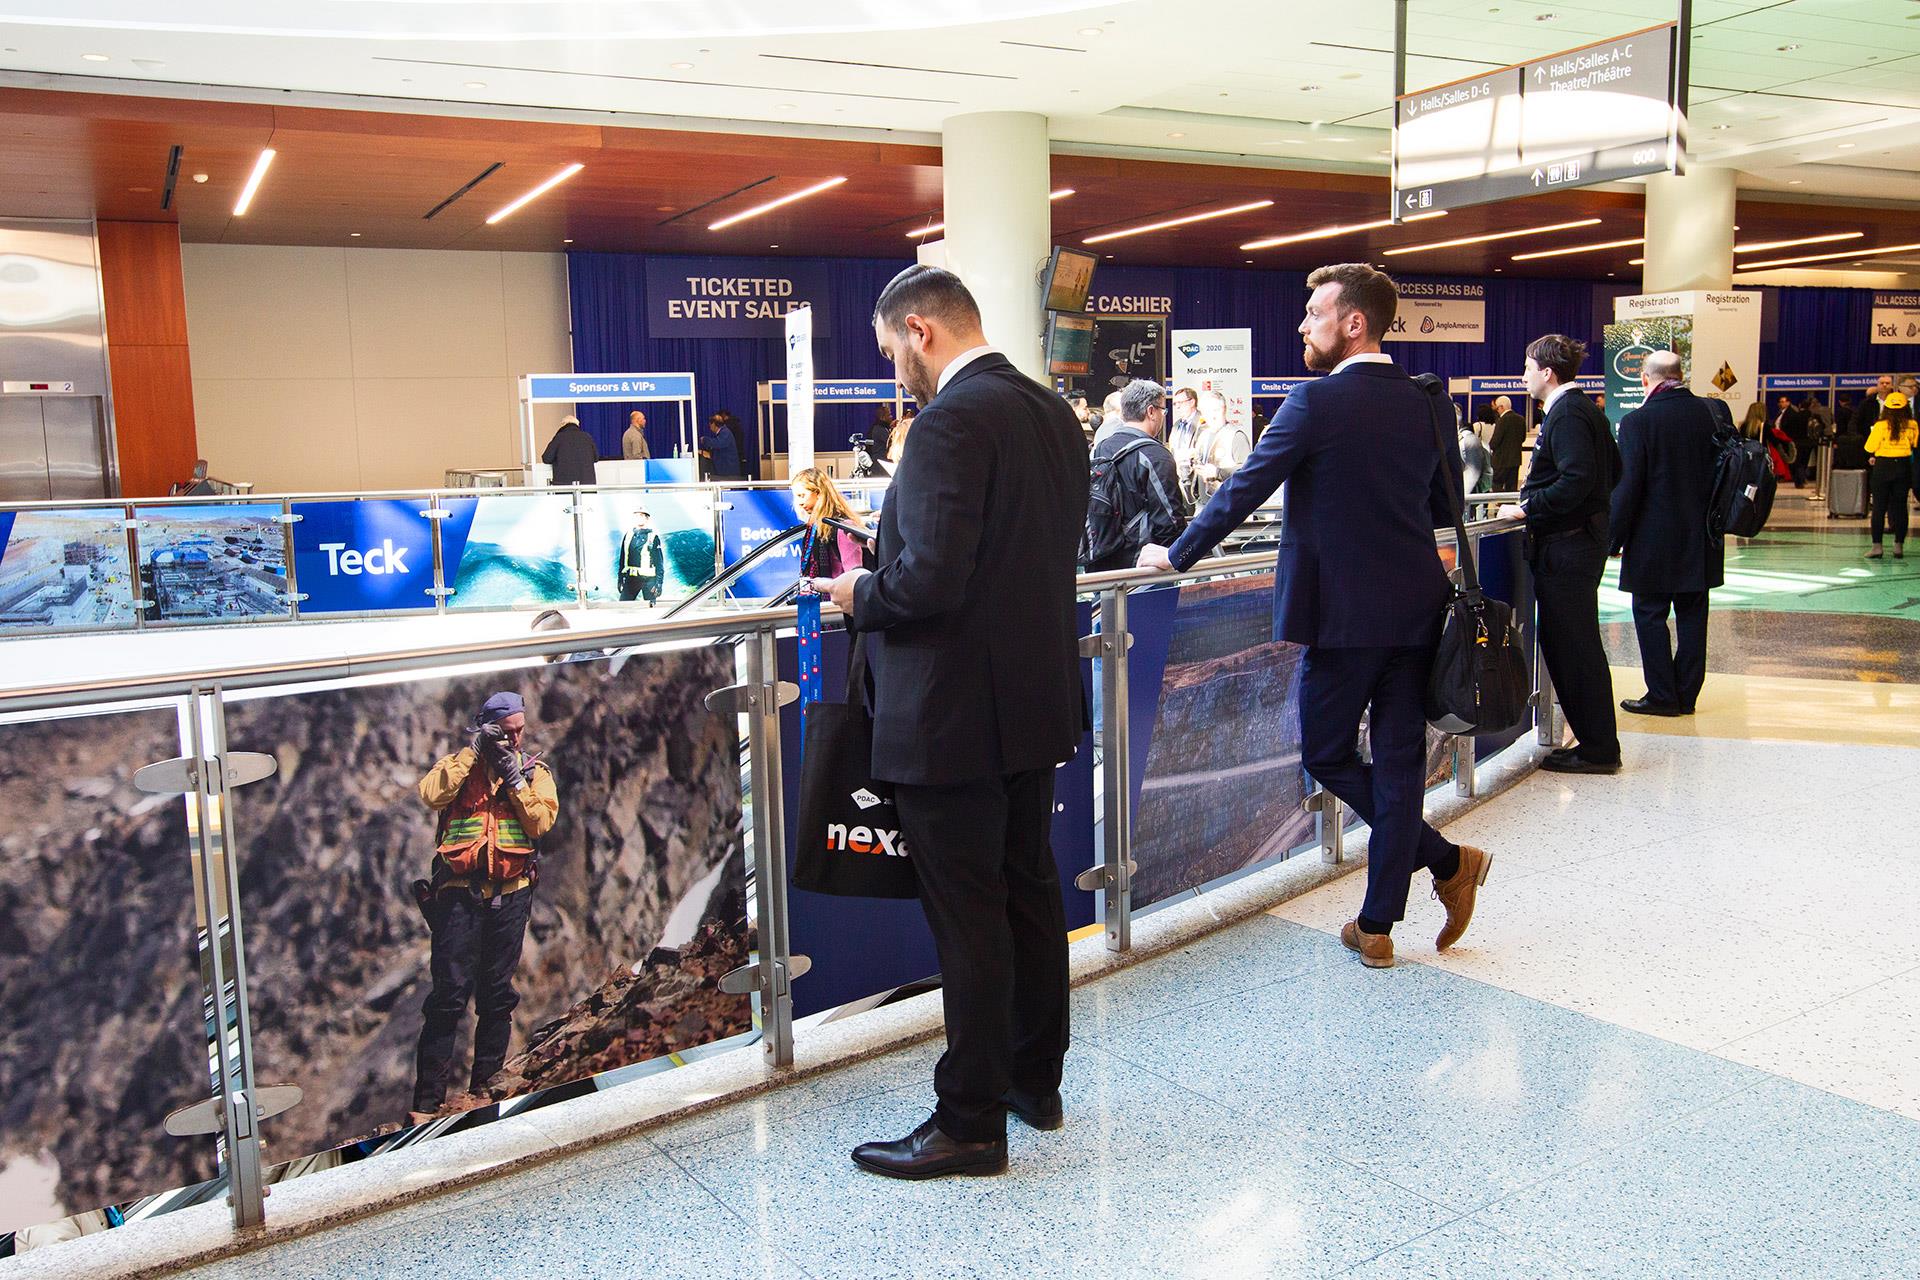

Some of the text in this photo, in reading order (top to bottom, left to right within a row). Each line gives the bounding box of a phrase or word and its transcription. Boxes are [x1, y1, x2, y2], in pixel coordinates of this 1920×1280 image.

[1550, 53, 1609, 78] Halls/Salles
[1550, 65, 1632, 93] Theatre/Théâtre
[1420, 90, 1469, 112] Halls/Salles
[1632, 148, 1656, 165] 600
[686, 277, 793, 296] TICKETED
[1436, 284, 1461, 296] PASS
[1463, 285, 1484, 296] BAG
[1098, 295, 1172, 313] CASHIER
[1629, 296, 1680, 309] Registration
[1705, 293, 1750, 305] Registration
[1875, 296, 1888, 305] ALL
[1889, 296, 1918, 305] ACCESS
[668, 300, 741, 318] EVENT
[1436, 321, 1480, 331] AngloAmerican
[1876, 323, 1897, 336] Teck
[1187, 367, 1207, 375] Media
[64, 382, 72, 391] 2
[569, 382, 656, 394] Sponsors & VIPs
[829, 387, 853, 395] Event
[854, 386, 877, 395] Sales
[1261, 383, 1281, 391] Onsite
[1480, 381, 1507, 389] Attendees
[319, 539, 409, 576] Teck
[856, 795, 876, 803] PDAC
